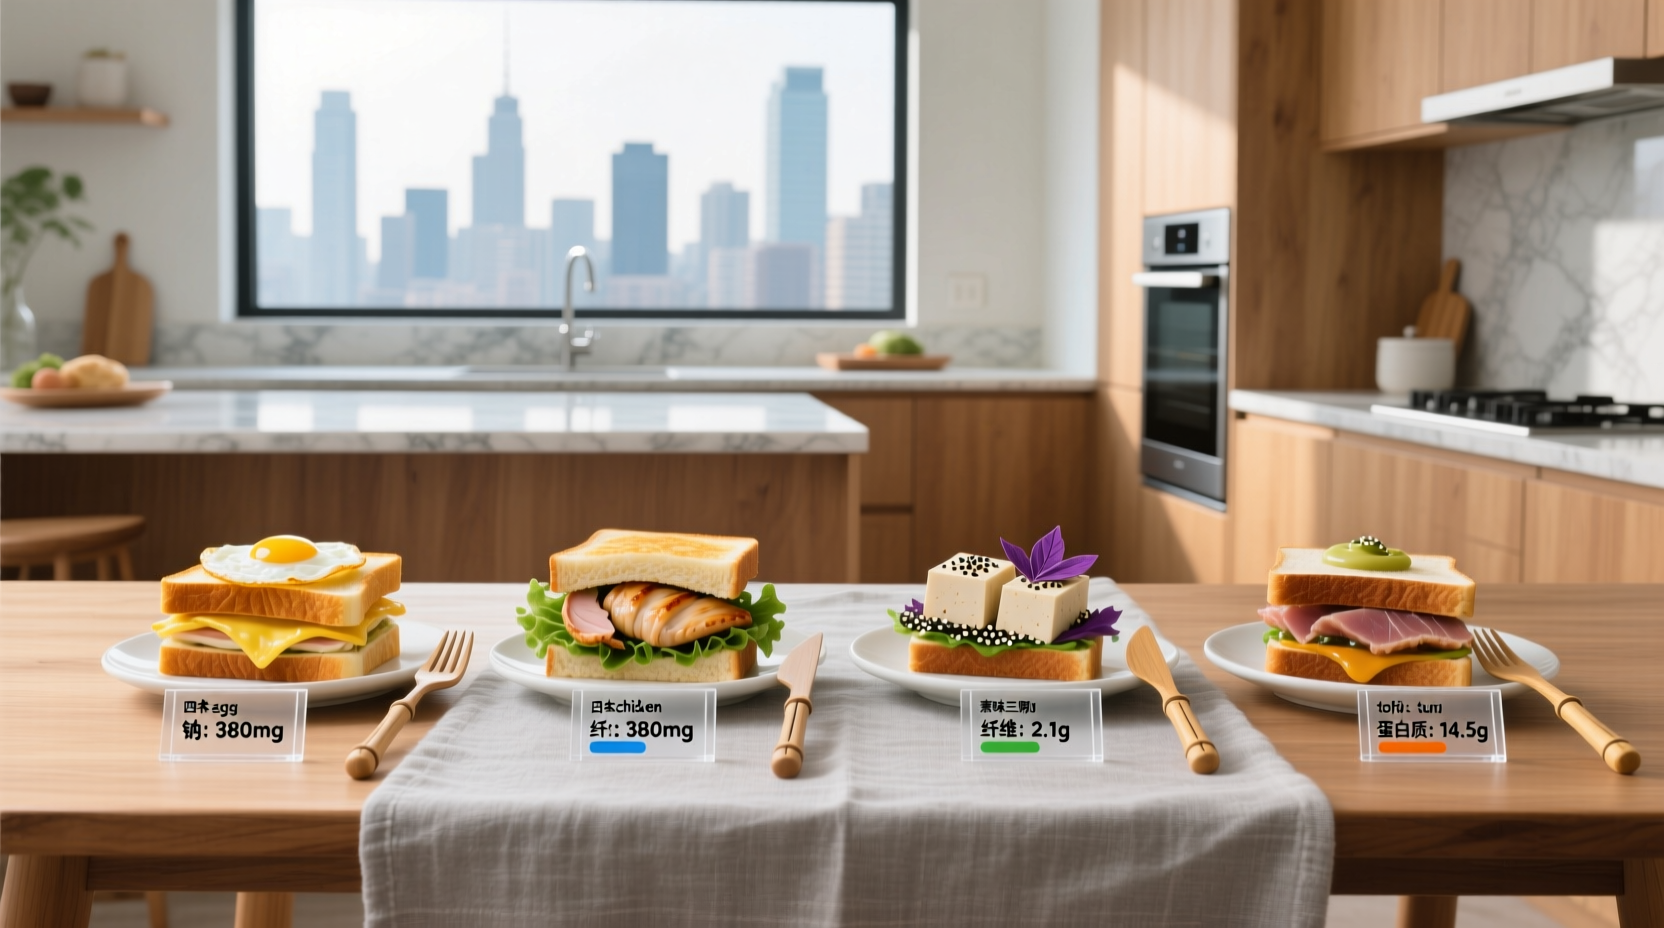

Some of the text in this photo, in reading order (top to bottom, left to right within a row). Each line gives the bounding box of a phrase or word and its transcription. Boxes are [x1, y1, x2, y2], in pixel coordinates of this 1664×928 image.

[215, 721, 284, 743] 380mg
[626, 720, 694, 743] 380mg
[1031, 721, 1070, 743] 2.1g
[1440, 721, 1489, 743] 14.5g
